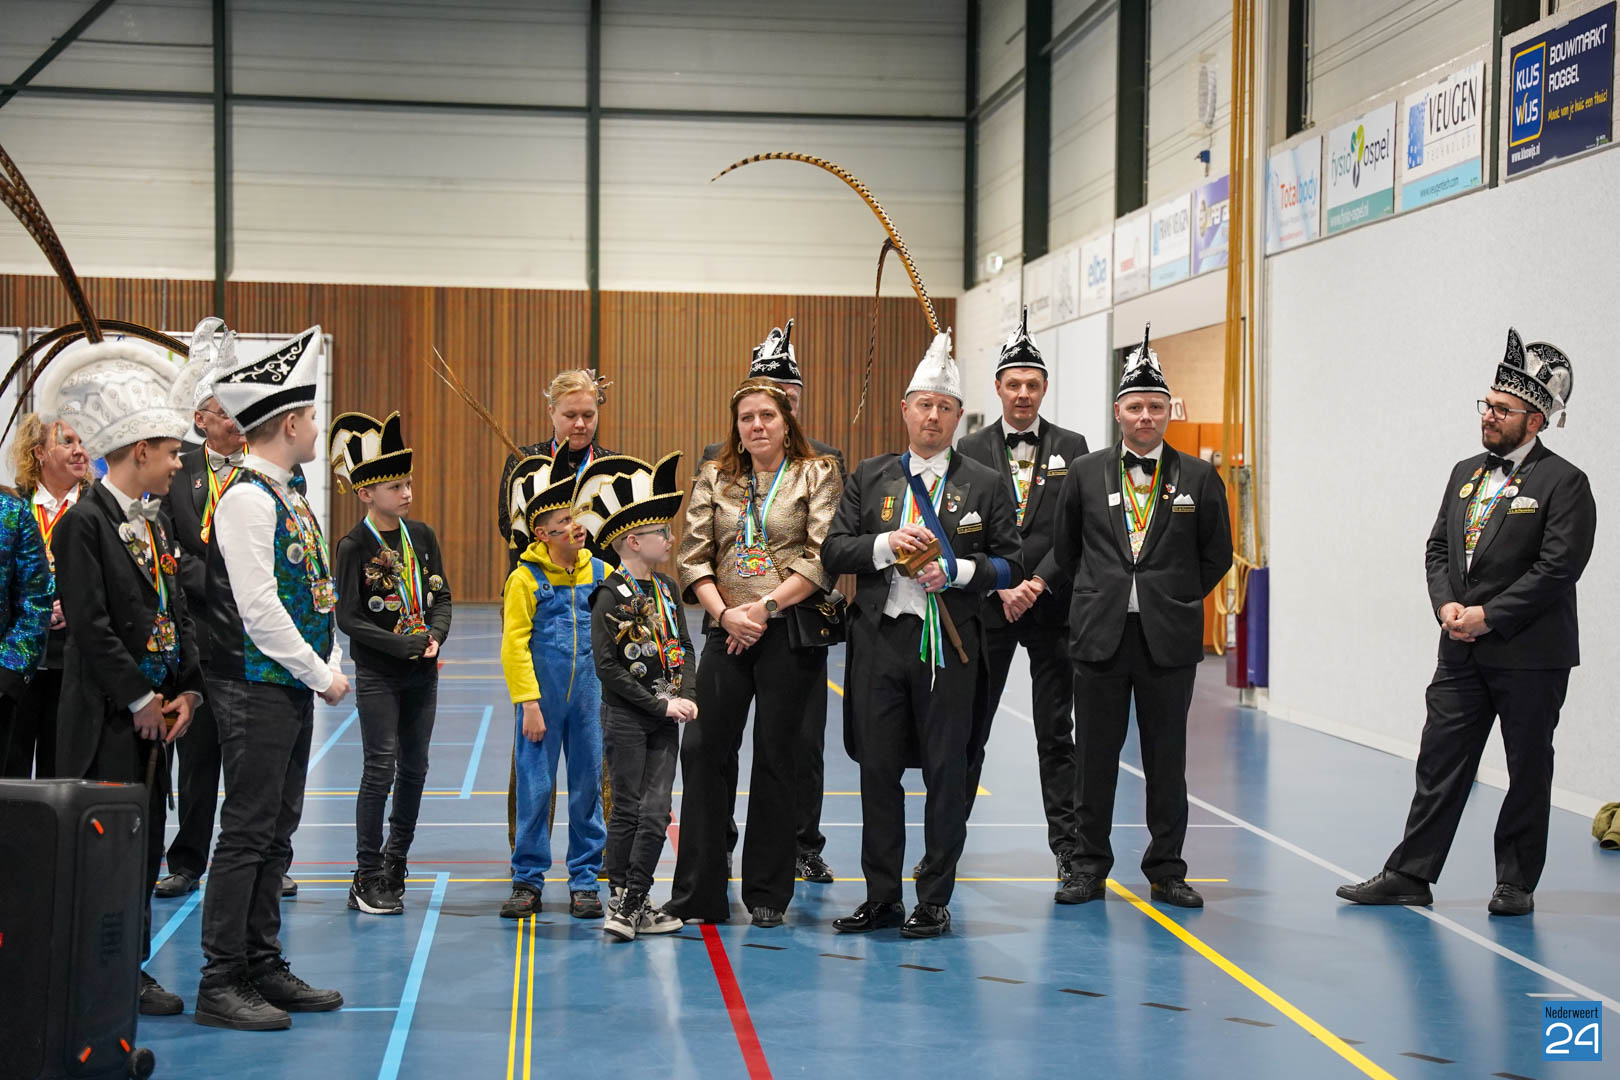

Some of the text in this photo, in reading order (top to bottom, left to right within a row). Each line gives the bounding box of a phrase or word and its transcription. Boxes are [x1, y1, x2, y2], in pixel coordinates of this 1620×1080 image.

[1549, 24, 1608, 65] BOUWMARKT
[1516, 63, 1540, 92] KLUS
[1548, 64, 1580, 92] ROGGEL
[1429, 76, 1478, 135] VEUGEN
[1516, 93, 1538, 126] WIJS
[1331, 129, 1389, 186] fysio ospel
